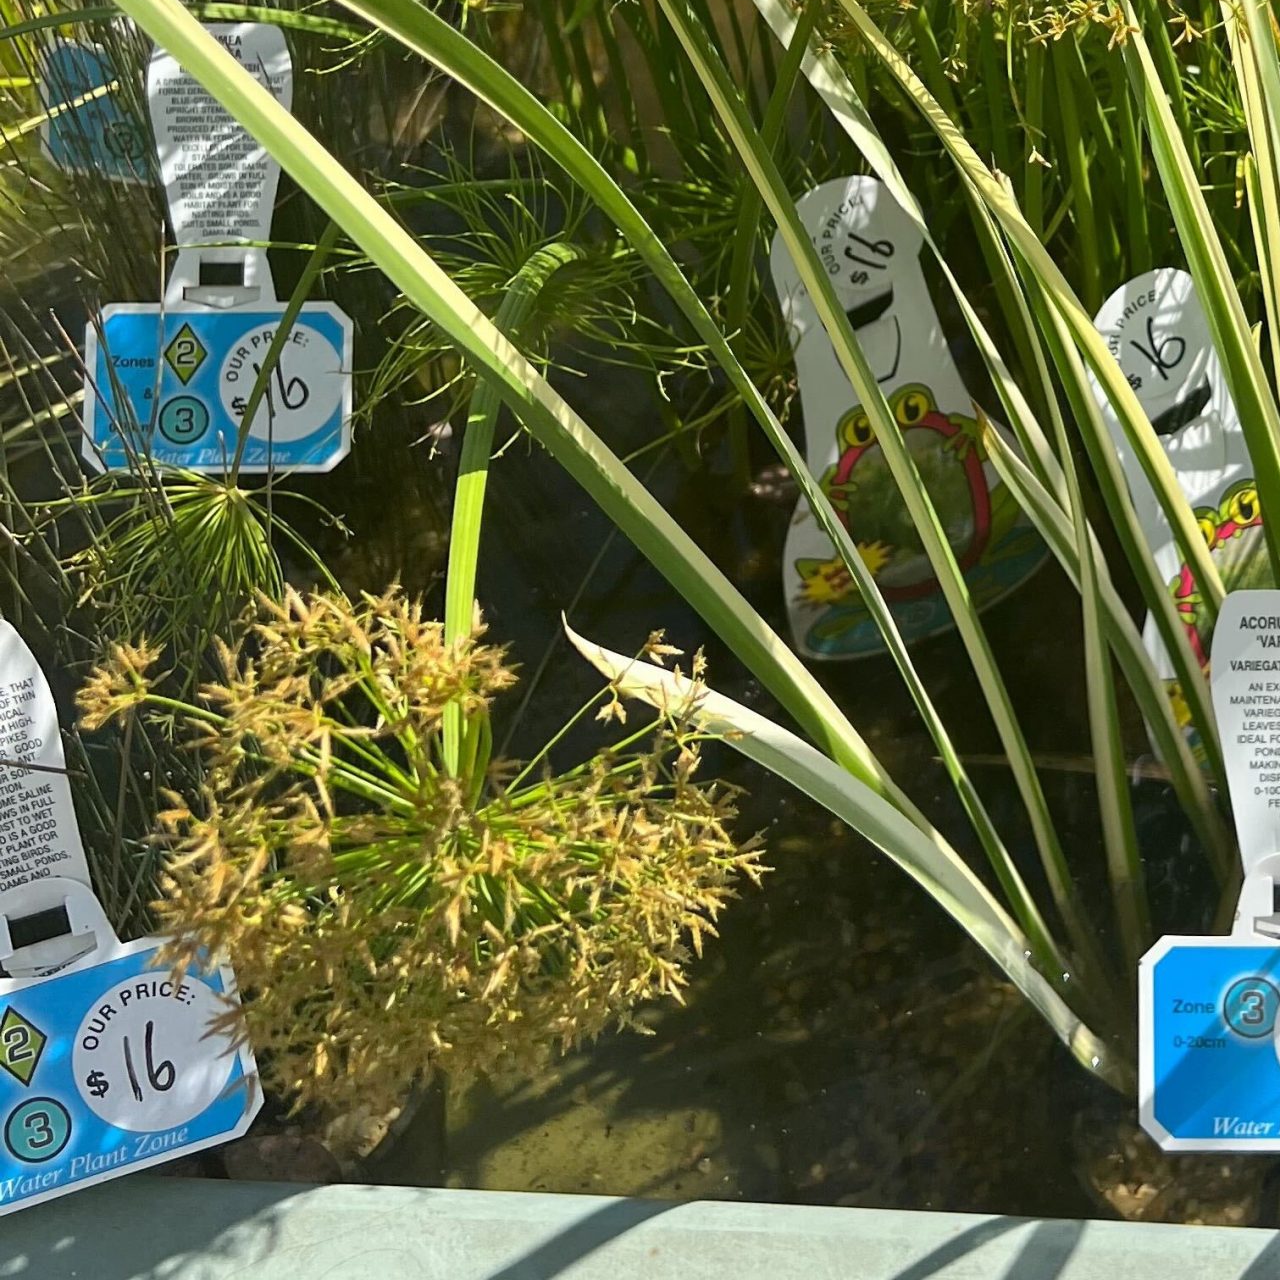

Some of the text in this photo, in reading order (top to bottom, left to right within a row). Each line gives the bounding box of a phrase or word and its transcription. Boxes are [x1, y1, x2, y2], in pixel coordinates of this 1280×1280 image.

[821, 243, 841, 275] OUR
[176, 340, 196, 365] 2
[1130, 316, 1186, 381] 16
[112, 355, 154, 368] Zones
[226, 346, 251, 382] OUR
[175, 408, 195, 433] 3
[9, 677, 34, 693] THAT
[1248, 683, 1263, 692] AN
[13, 692, 36, 706] THIN
[8, 717, 35, 732] HIGH.
[14, 738, 43, 754] GOOD
[1237, 734, 1266, 744] IDEAL
[18, 783, 53, 801] SALINE
[19, 803, 30, 813] IN
[30, 796, 56, 810] FULL
[17, 815, 31, 826] TO
[32, 808, 54, 820] WET
[9, 832, 19, 841] IS
[29, 819, 57, 834] GOOD
[6, 837, 36, 854] PLANT
[37, 831, 59, 843] FOR
[0, 863, 34, 880] SMALL
[0, 867, 51, 892] DAMS AND
[83, 980, 196, 1051] OUR PRICE:
[1173, 999, 1216, 1014] Zone
[1240, 990, 1266, 1026] 3
[3, 1025, 34, 1064] 2
[1173, 1035, 1227, 1049] 0-20cm
[86, 1020, 176, 1103] $ 16
[23, 1111, 55, 1149] 3
[1212, 1116, 1274, 1136] Water
[0, 1125, 189, 1202] Water Plant Zone
